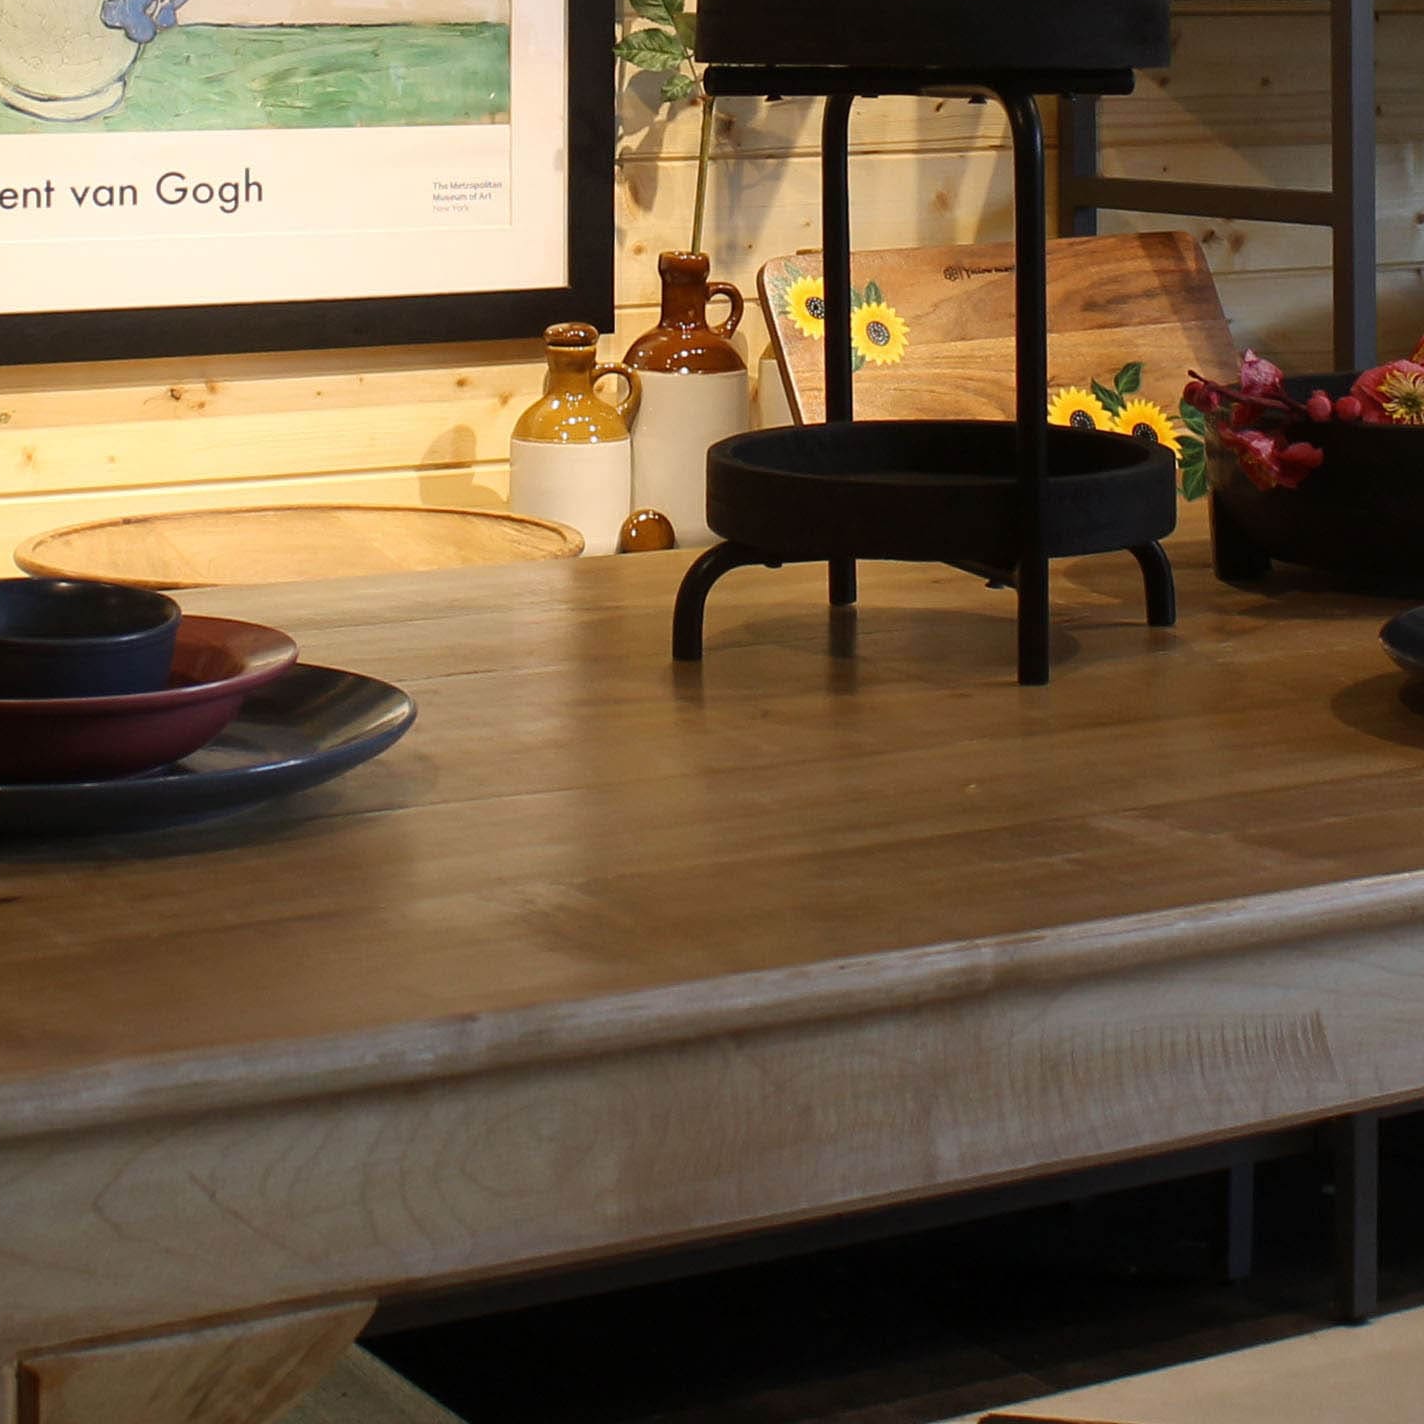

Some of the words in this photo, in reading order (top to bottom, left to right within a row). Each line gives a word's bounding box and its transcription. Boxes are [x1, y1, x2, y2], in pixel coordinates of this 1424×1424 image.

[433, 182, 449, 190] The
[450, 181, 502, 190] Metropolitan
[70, 183, 138, 208] van
[156, 168, 264, 214] Gogh
[433, 193, 468, 201] Museum
[469, 192, 478, 201] of
[479, 192, 492, 201] Art
